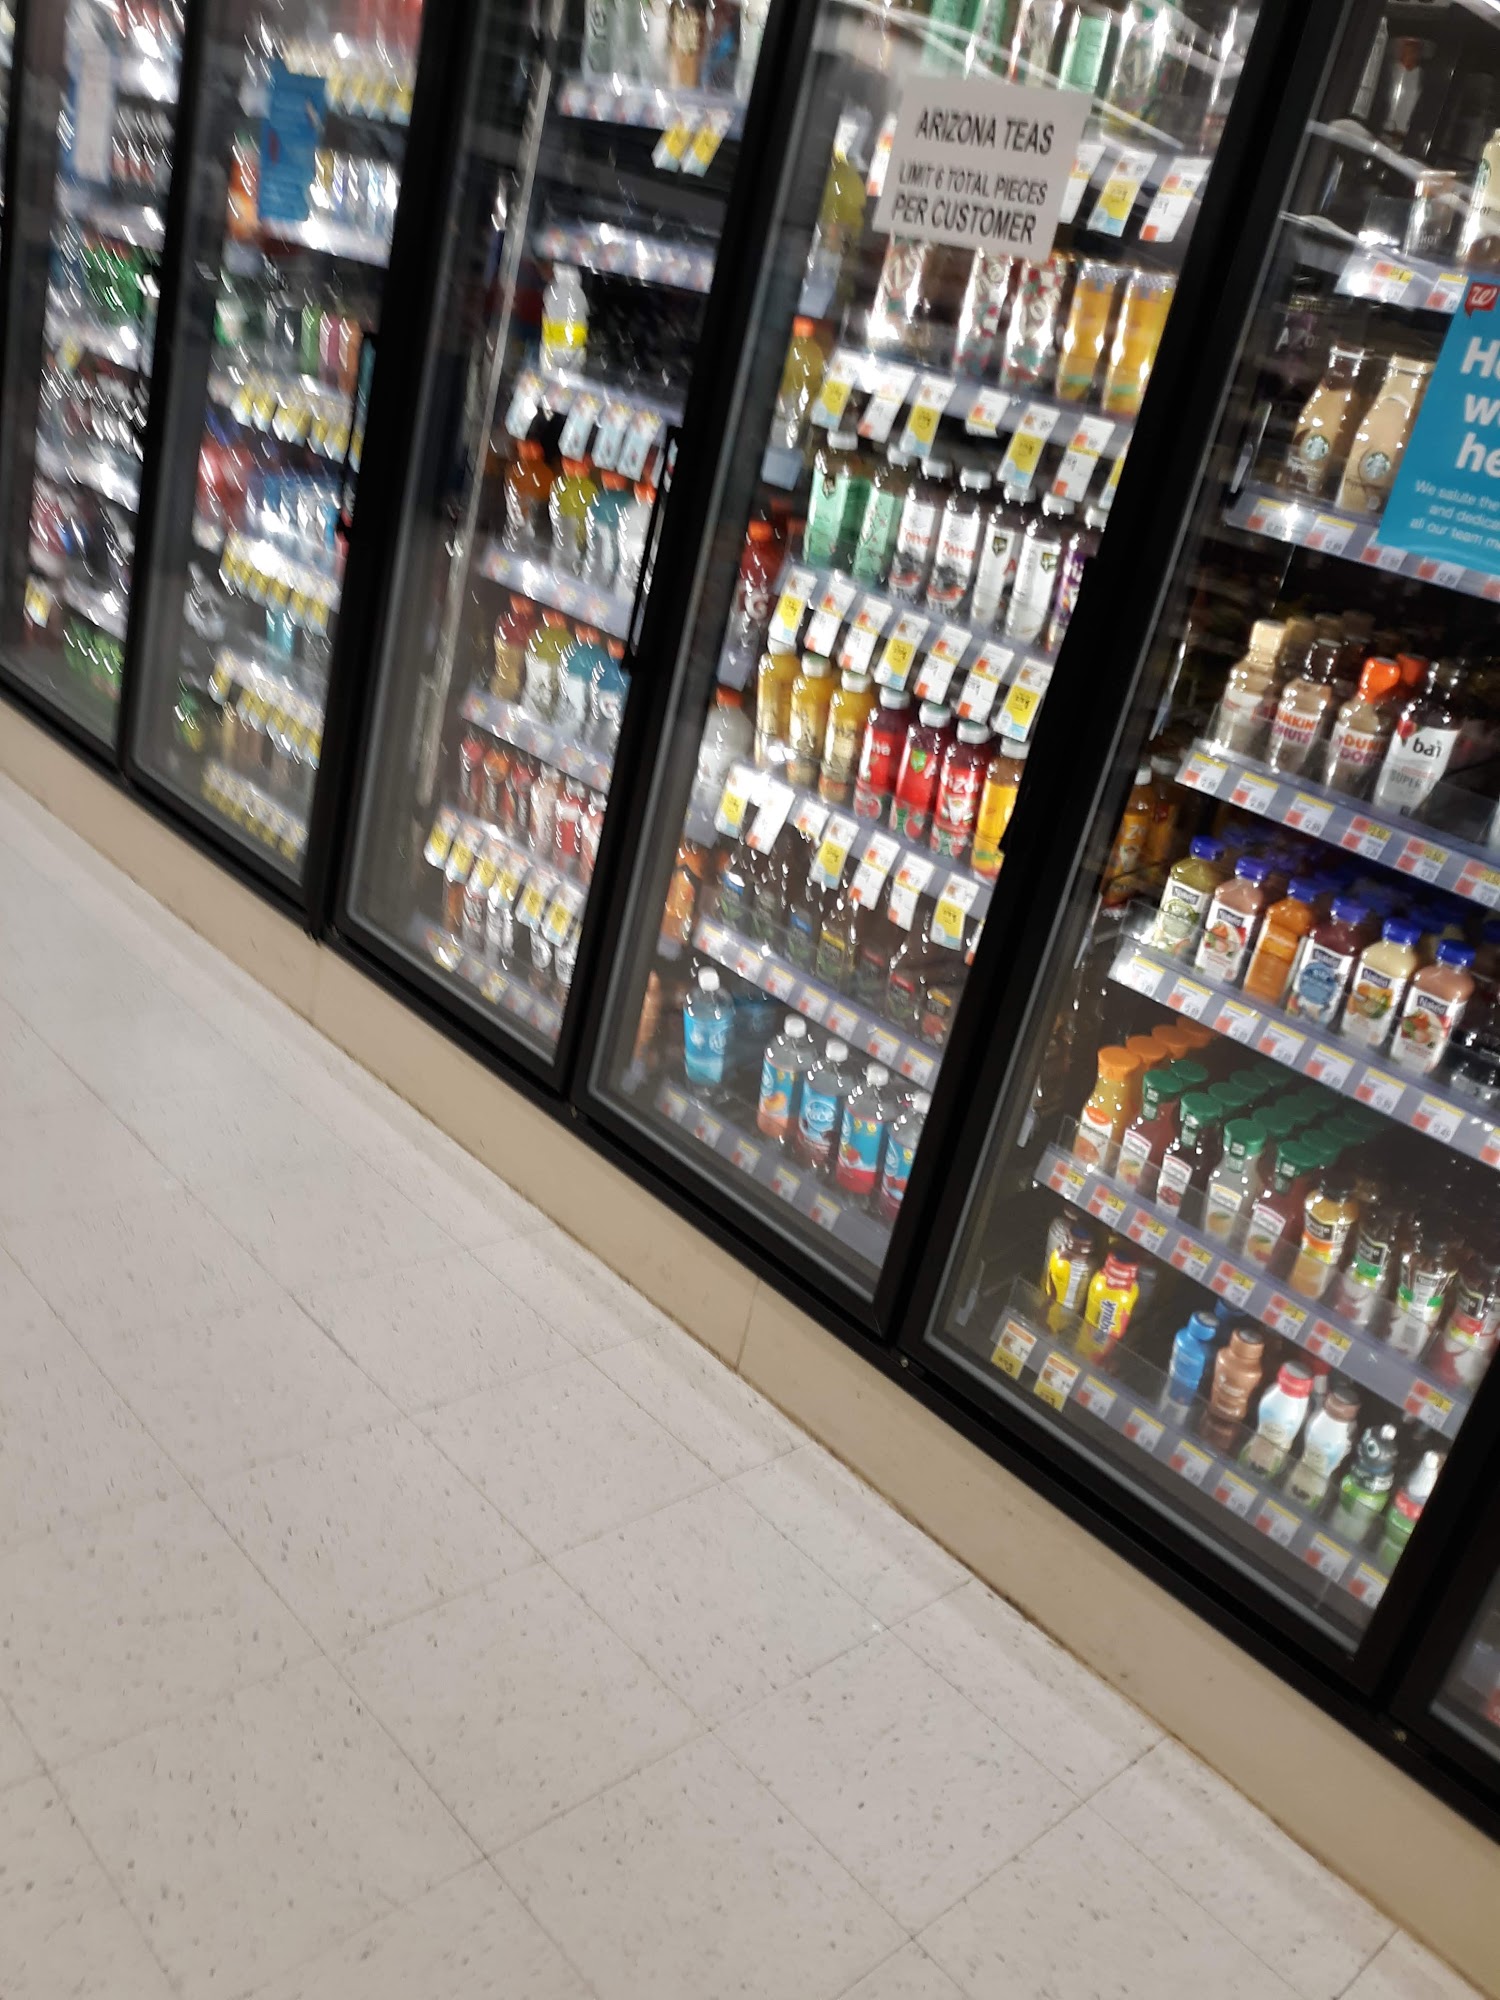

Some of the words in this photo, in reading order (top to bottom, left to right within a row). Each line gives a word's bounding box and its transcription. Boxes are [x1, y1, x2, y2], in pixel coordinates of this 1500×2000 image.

[916, 107, 996, 147] ARIZONA
[1004, 120, 1054, 154] TEAS
[900, 160, 935, 187] LIMIT
[949, 168, 990, 197] TOTAL
[994, 175, 1048, 206] PIECES
[893, 196, 928, 225] PER
[931, 202, 1036, 244] CUSTOMER
[1415, 480, 1436, 496] We
[1429, 504, 1455, 519] and
[1428, 523, 1448, 535] our
[1451, 527, 1483, 545] team
[1412, 737, 1442, 758] bai
